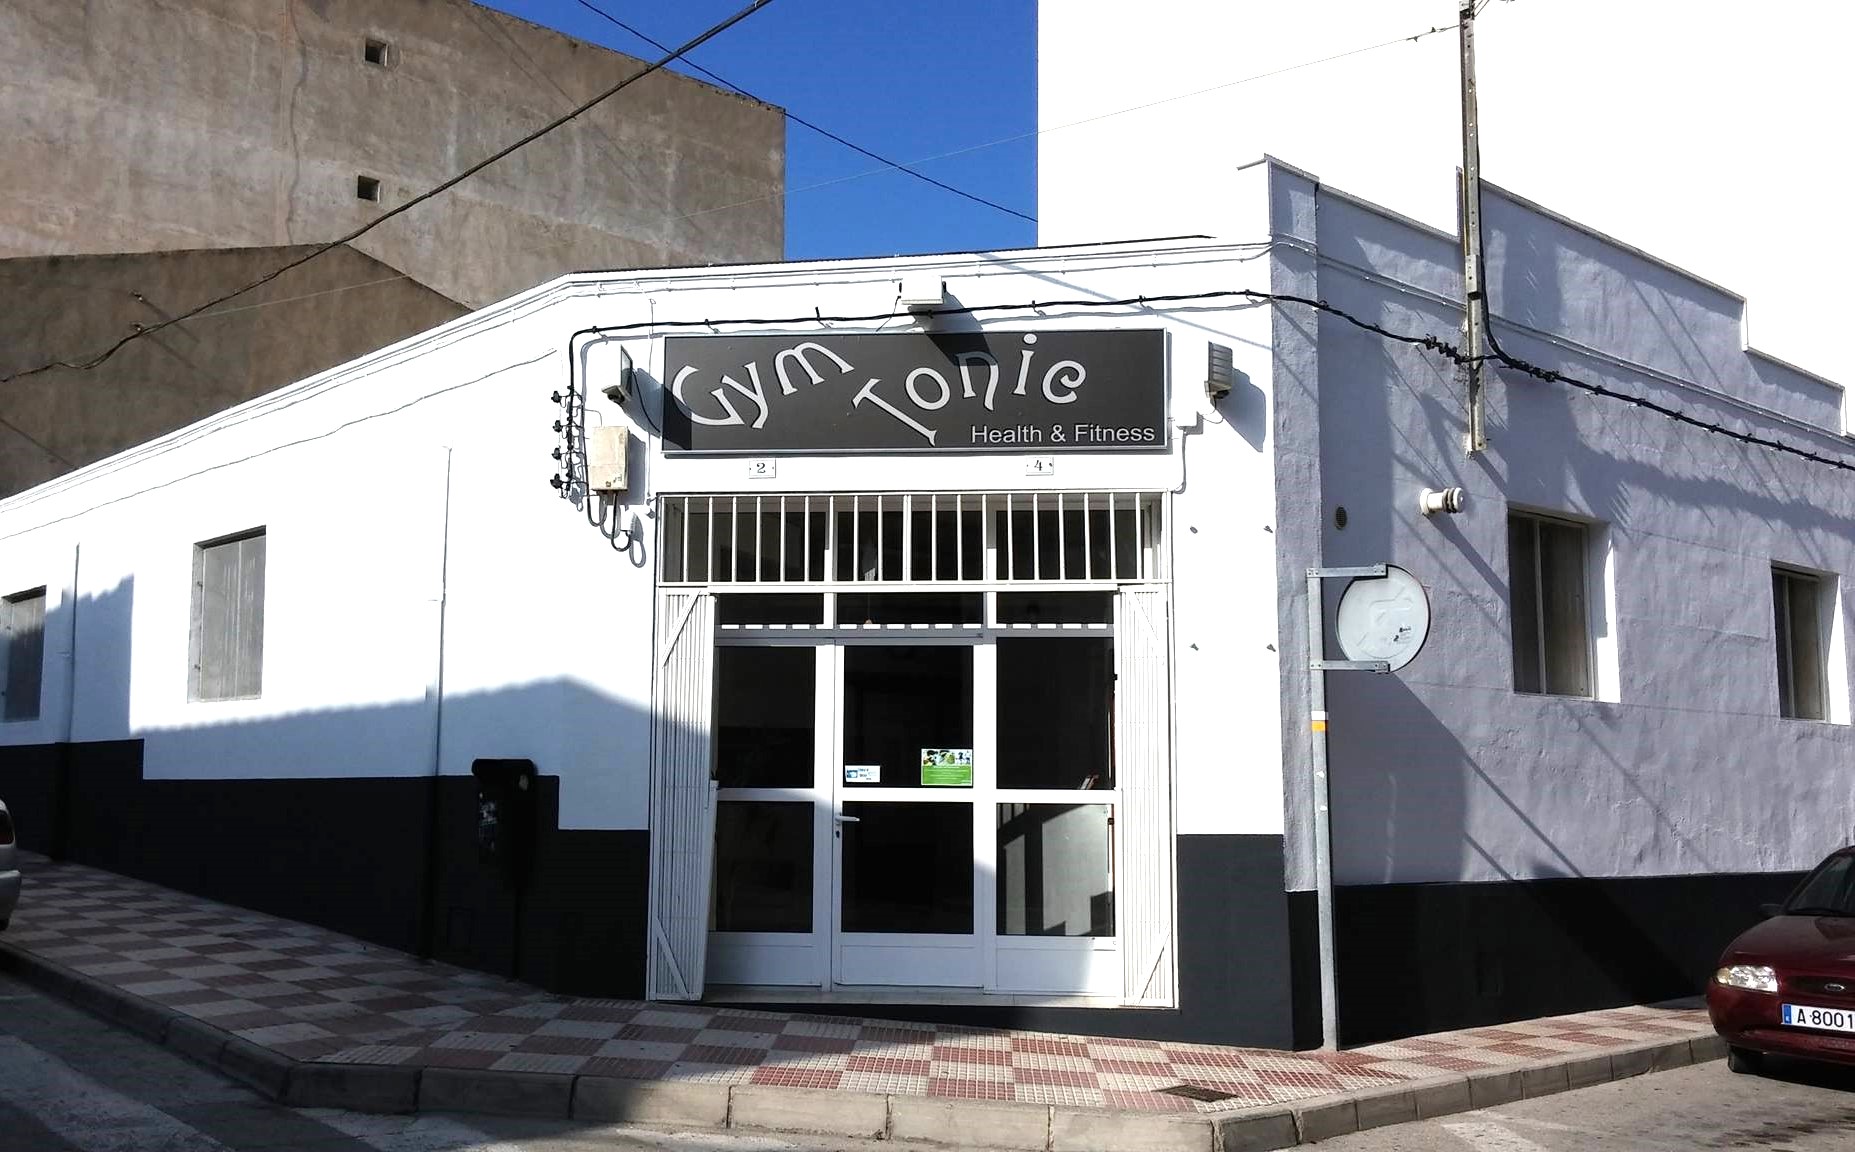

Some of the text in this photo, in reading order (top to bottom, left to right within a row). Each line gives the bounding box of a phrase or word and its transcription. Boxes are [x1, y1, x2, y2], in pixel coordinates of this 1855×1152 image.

[671, 341, 854, 429] Gym
[851, 333, 1087, 447] Tonic
[971, 423, 1156, 443] Health & Fitness
[756, 462, 766, 474] 2
[1033, 459, 1043, 472] 4
